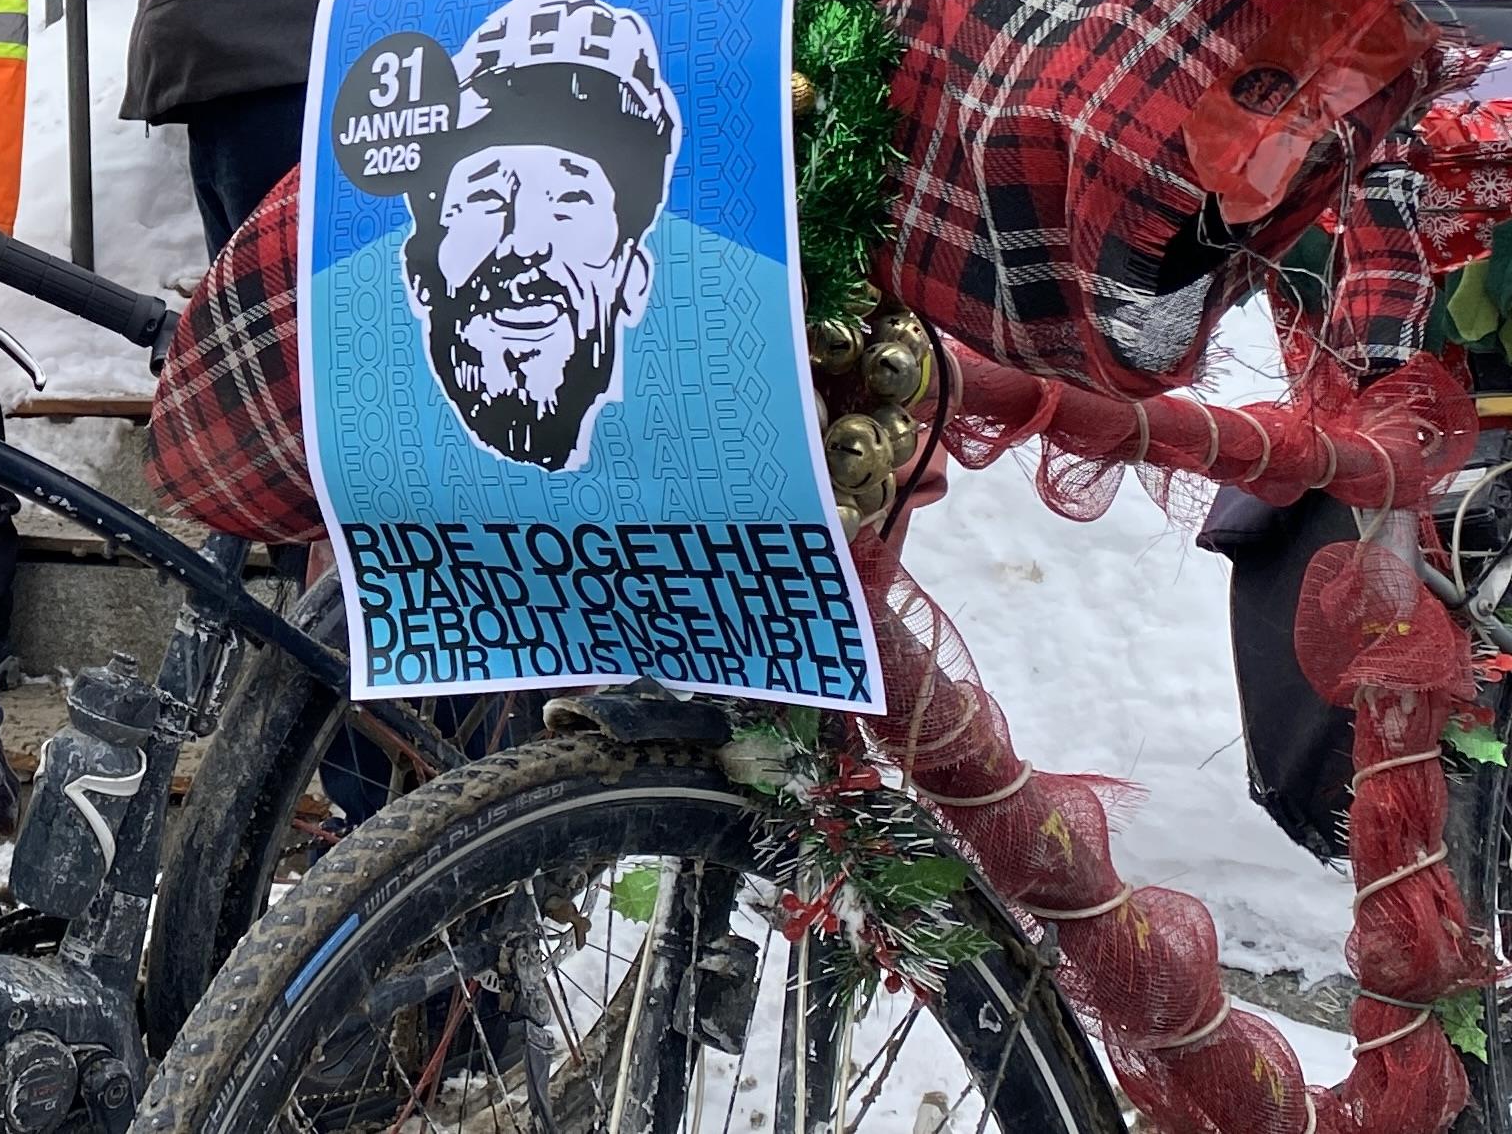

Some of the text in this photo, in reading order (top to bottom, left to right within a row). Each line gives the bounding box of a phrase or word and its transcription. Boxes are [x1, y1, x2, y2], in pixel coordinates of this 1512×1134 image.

[369, 46, 424, 108] 31
[339, 104, 450, 146] JANVIER
[363, 142, 421, 176] 2026
[341, 523, 844, 577] RIDE TOGETHER
[356, 565, 856, 620] STAND TOGETHER
[364, 604, 867, 664] DEBOUT ENSEMBLE
[366, 641, 873, 704] POUR TOUS POUR ALEX
